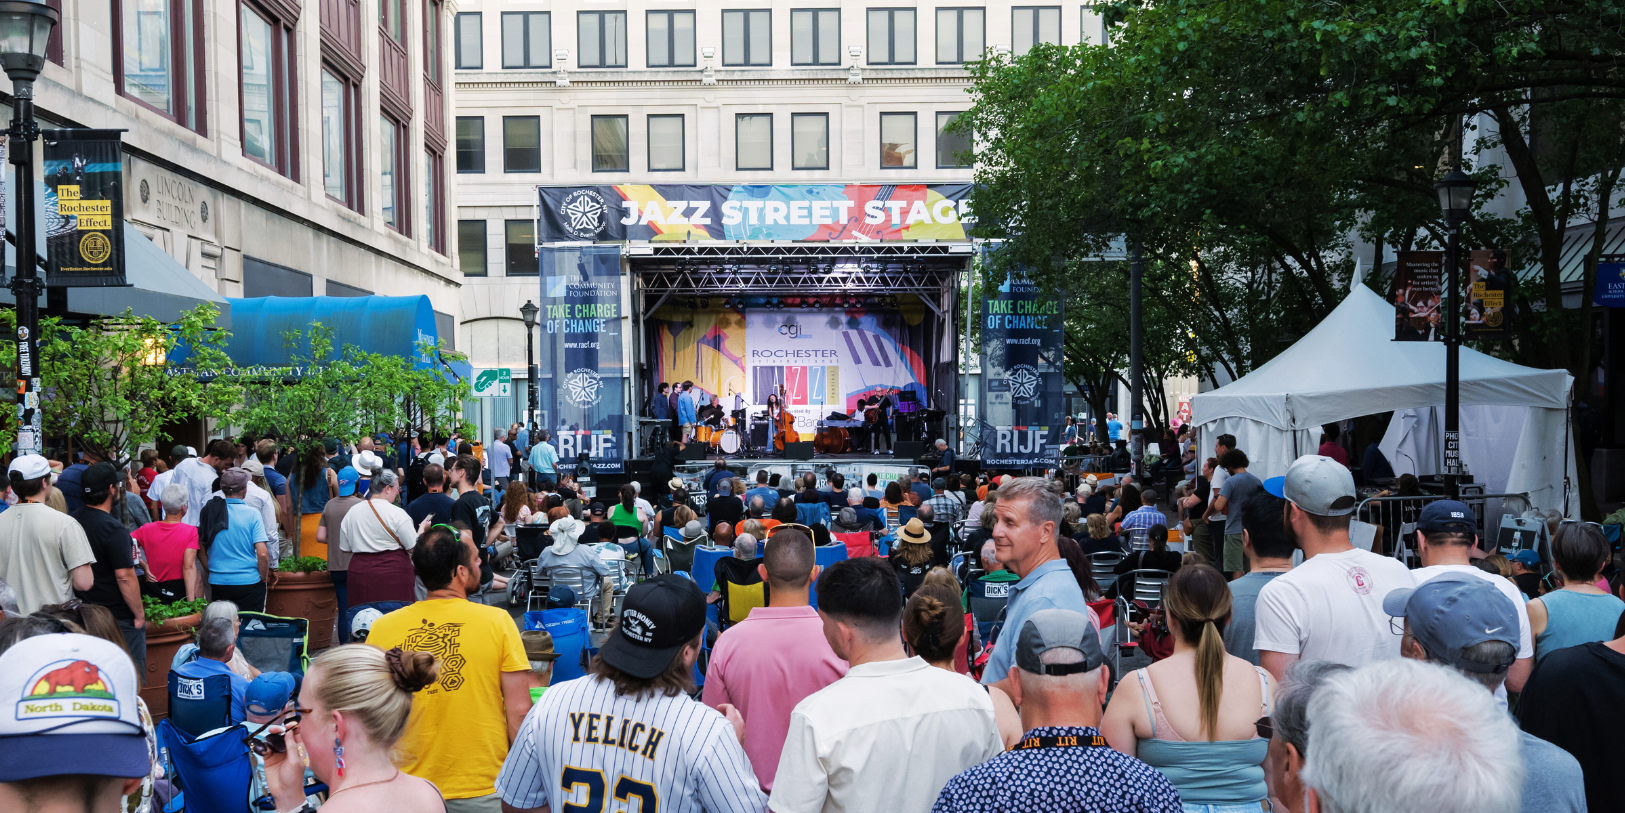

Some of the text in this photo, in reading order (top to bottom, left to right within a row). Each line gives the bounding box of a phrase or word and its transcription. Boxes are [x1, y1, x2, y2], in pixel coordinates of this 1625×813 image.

[59, 188, 78, 197] The
[157, 174, 194, 204] LINCOLN
[60, 203, 110, 212] Rochester
[566, 194, 573, 202] OF
[602, 204, 608, 214] NY
[157, 200, 196, 230] BUILDING
[620, 200, 978, 225] JAZZ STREET STAGE
[79, 218, 110, 227] Effect.
[546, 304, 617, 318] TAKE CHARGE
[988, 300, 1013, 314] TAKE
[546, 319, 606, 334] OF CHANGE
[988, 315, 1001, 329] OF
[564, 341, 600, 349] www.racf.org
[1006, 337, 1041, 346] www.racf.org
[754, 366, 822, 405] JAZZ
[798, 416, 820, 427] Ban
[559, 434, 612, 458] RIJF
[996, 430, 1048, 454] RIJF
[636, 612, 656, 629] HONEY
[24, 702, 113, 714] North Dakota
[569, 712, 665, 761] YELICH
[1022, 738, 1040, 749] RIT
[1056, 736, 1077, 746] RIT
[1092, 736, 1105, 746] RIT
